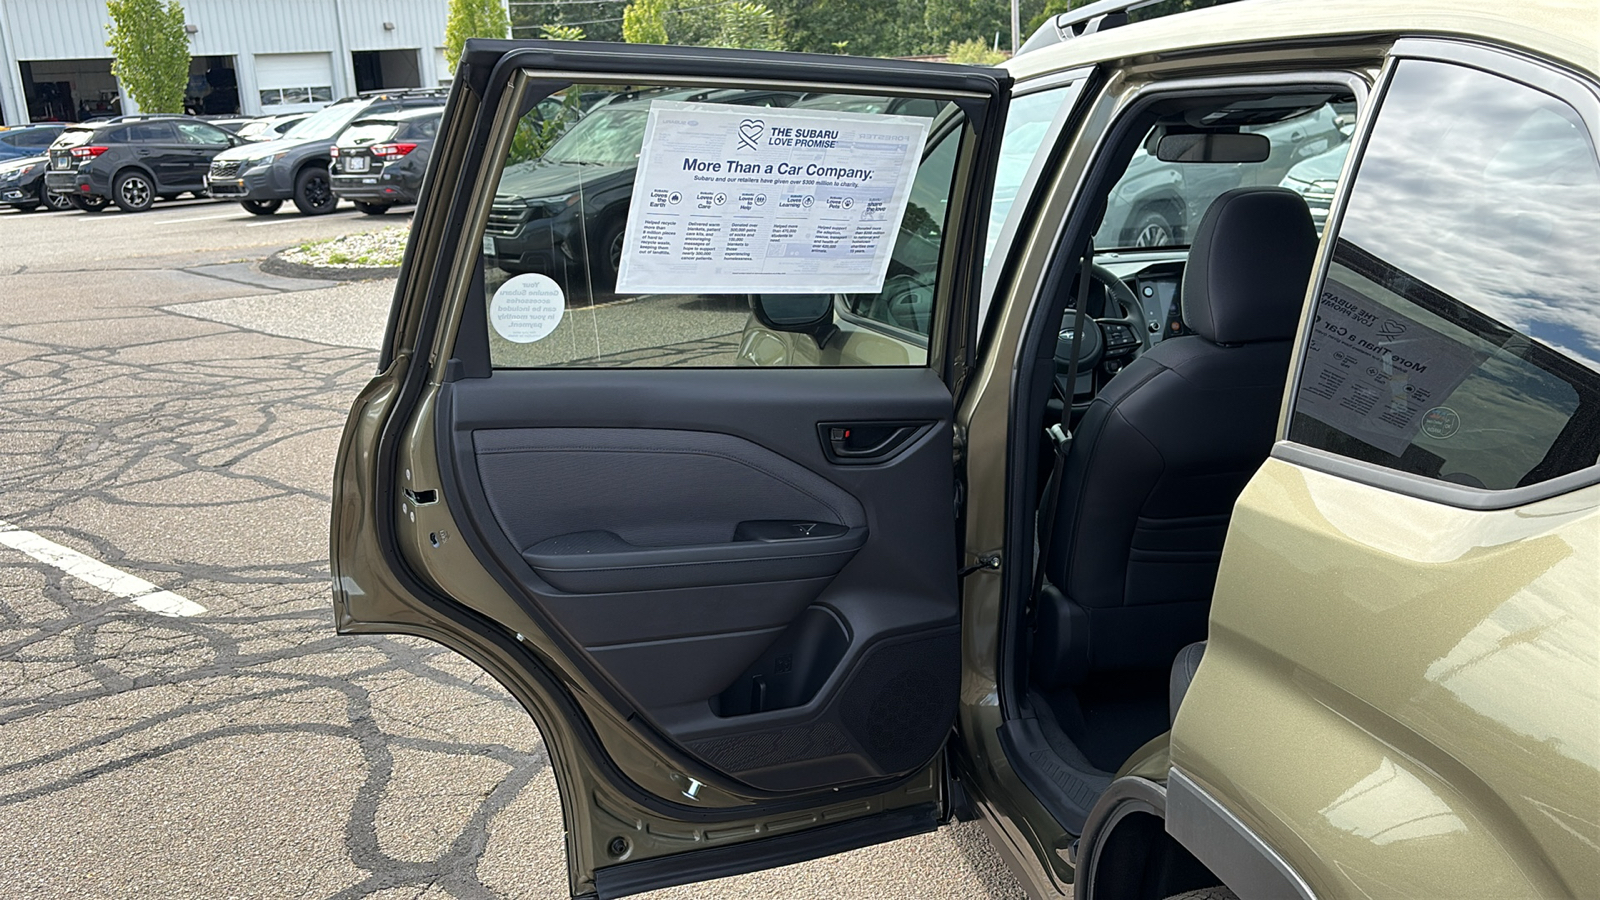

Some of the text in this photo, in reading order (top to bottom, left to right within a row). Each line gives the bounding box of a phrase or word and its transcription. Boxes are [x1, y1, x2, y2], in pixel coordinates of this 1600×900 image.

[772, 128, 792, 136] THE
[795, 129, 838, 139] SUBARU
[768, 137, 836, 148] LOVE PROMISE
[683, 158, 872, 181] More Than a Car Company.
